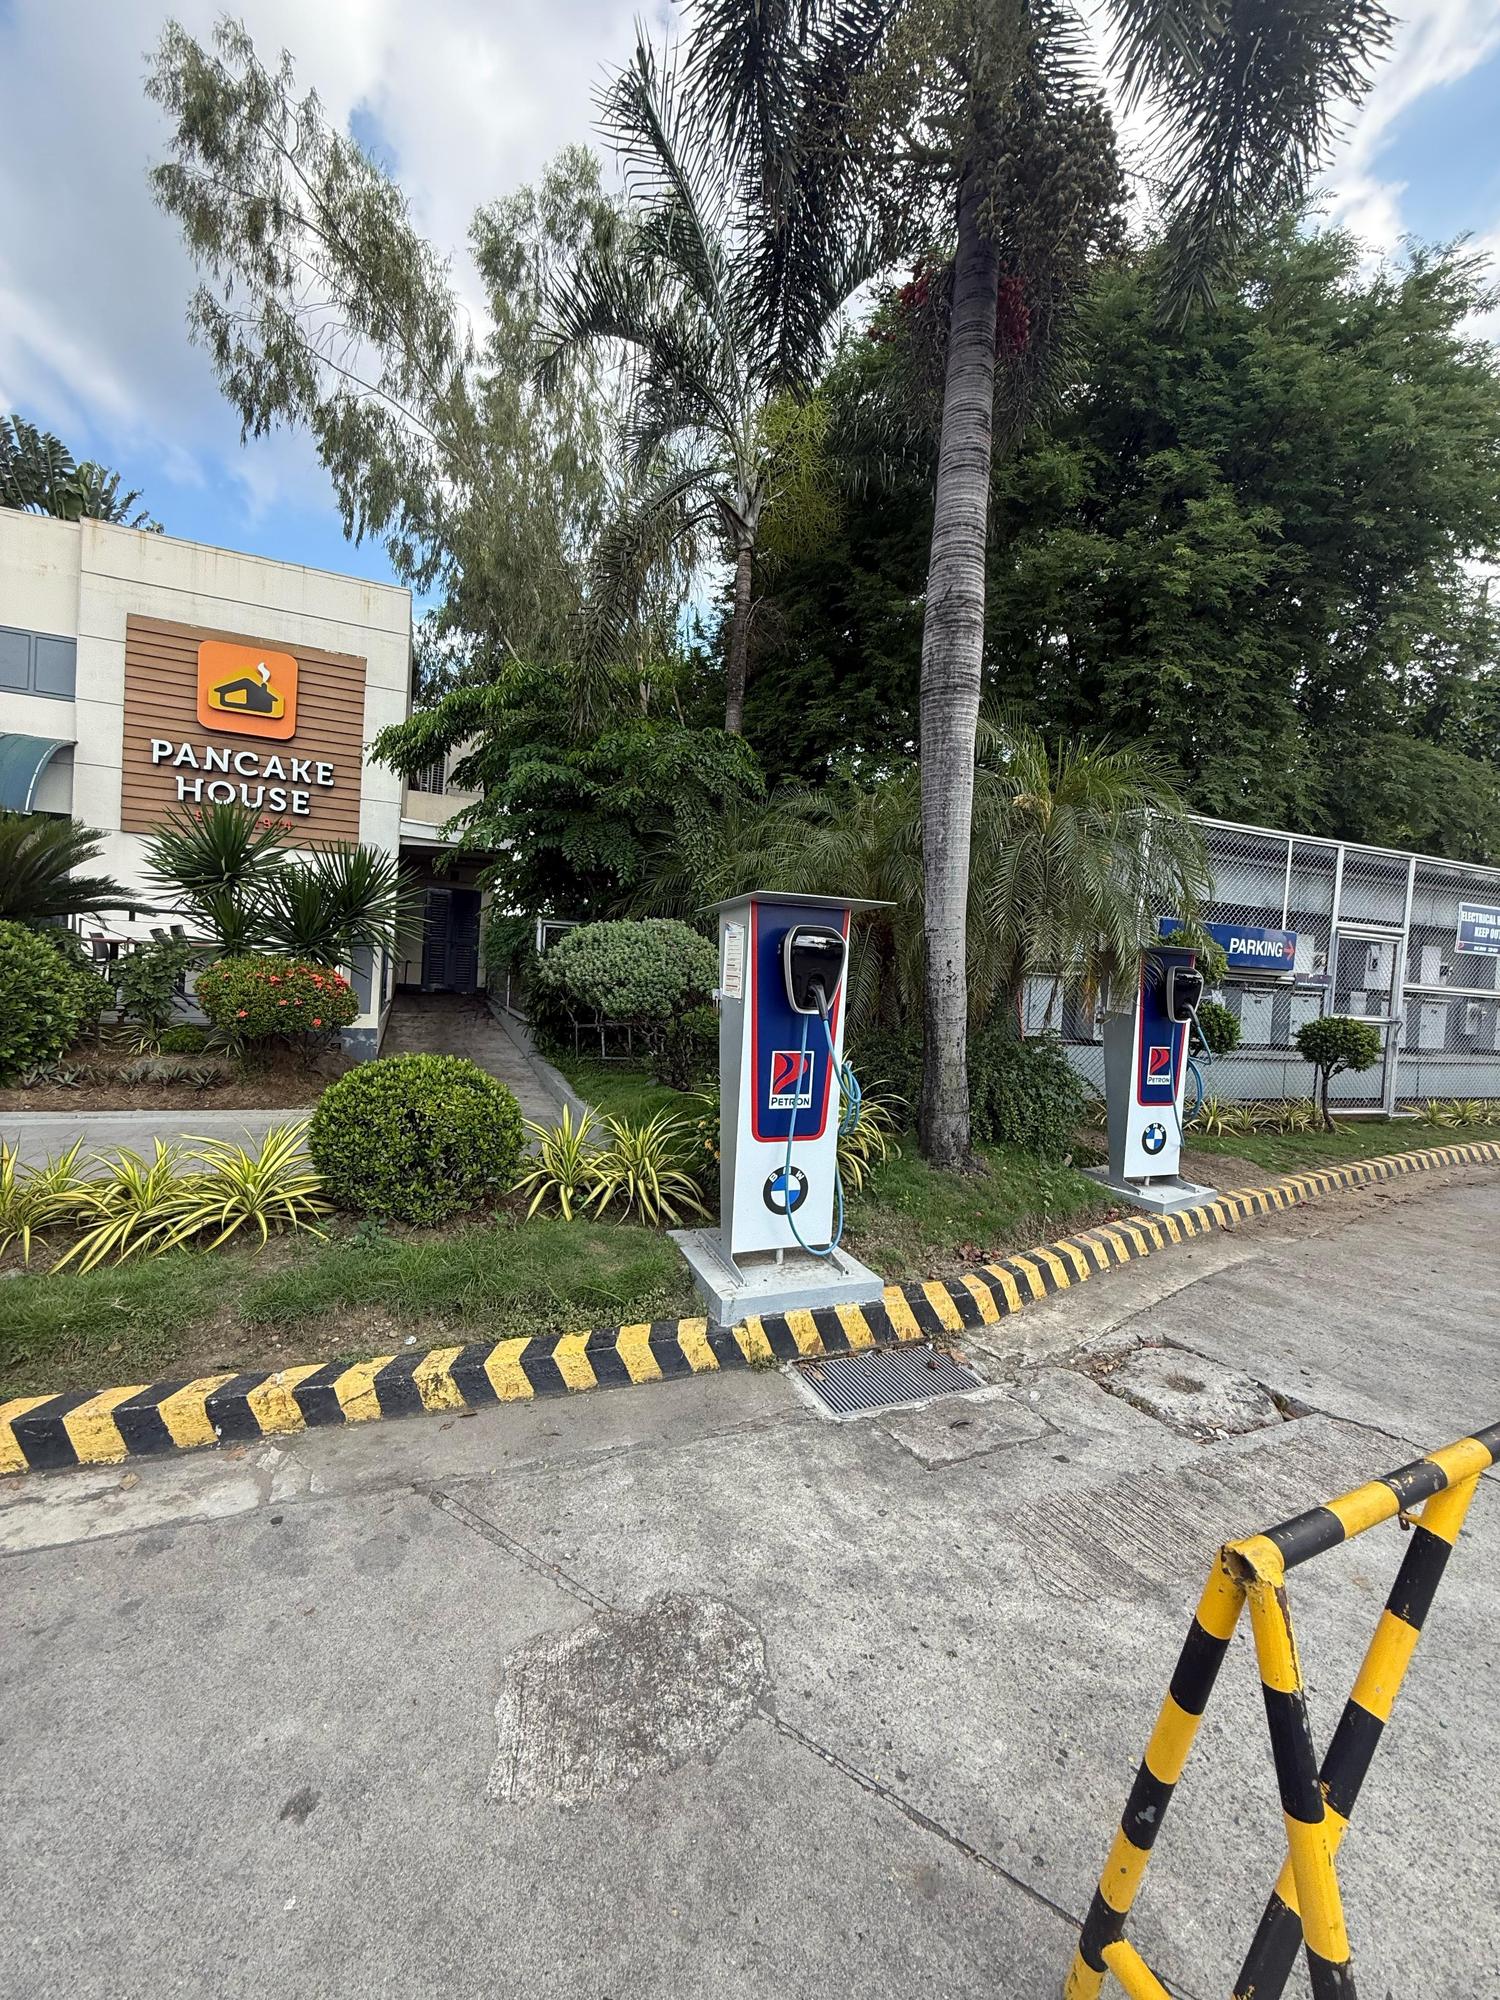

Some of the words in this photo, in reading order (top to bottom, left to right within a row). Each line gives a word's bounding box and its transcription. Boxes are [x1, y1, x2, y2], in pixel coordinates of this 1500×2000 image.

[151, 738, 334, 786] PANCAKE
[176, 775, 310, 814] HOUSE
[1461, 911, 1496, 925] ELECTRICAL
[1474, 926, 1490, 938] KEEP
[1229, 938, 1283, 957] PARKING
